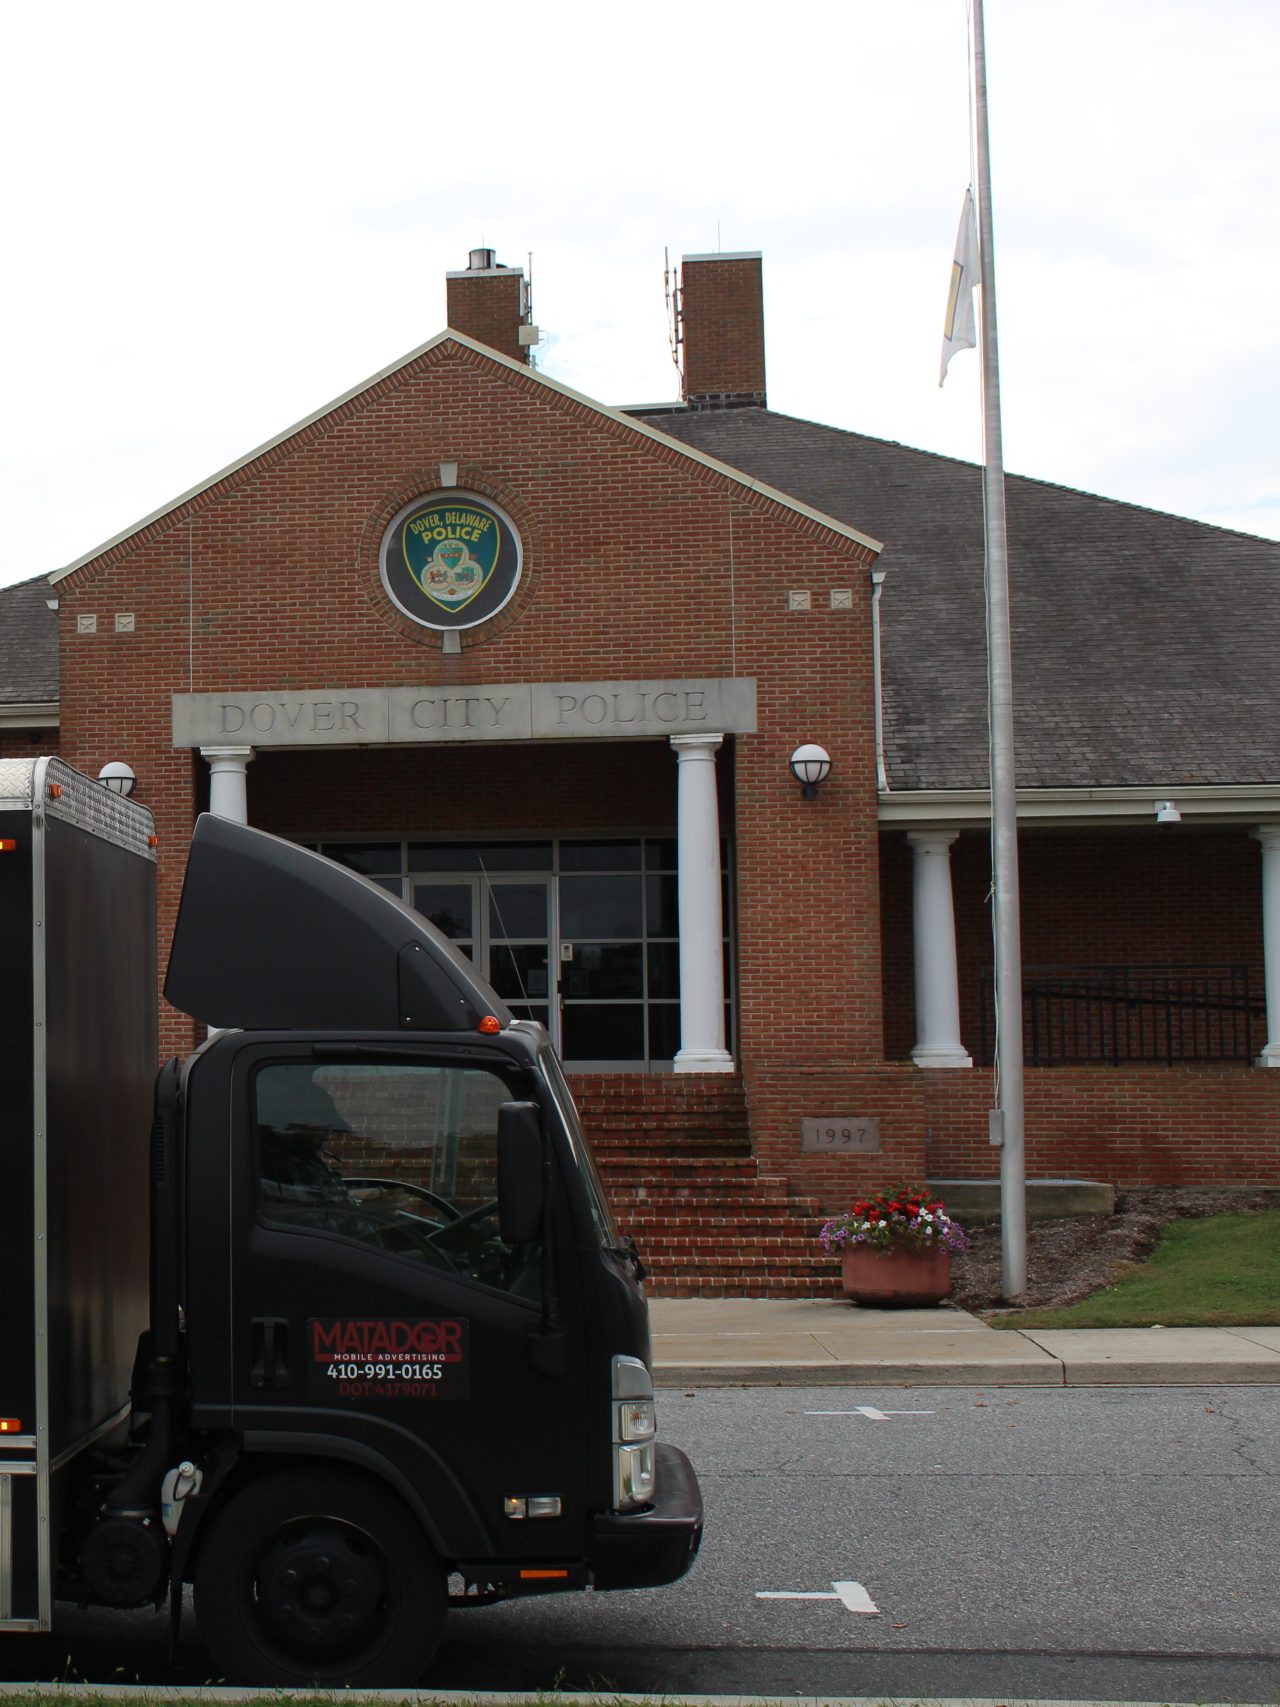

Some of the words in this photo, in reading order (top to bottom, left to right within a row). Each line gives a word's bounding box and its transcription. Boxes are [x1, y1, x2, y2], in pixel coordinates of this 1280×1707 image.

[445, 511, 493, 532] DELAWARE
[421, 526, 482, 544] POLICE
[219, 701, 365, 735] DOVER
[410, 697, 512, 730] CITY
[555, 691, 709, 726] POLICE
[816, 1128, 866, 1144] 1997
[313, 1320, 463, 1354] MATADOR
[334, 1353, 373, 1361] MOBILE
[378, 1353, 446, 1361] ADVERTISING
[327, 1364, 443, 1379] 410-991-0165
[339, 1382, 438, 1397] DOT:4179071
